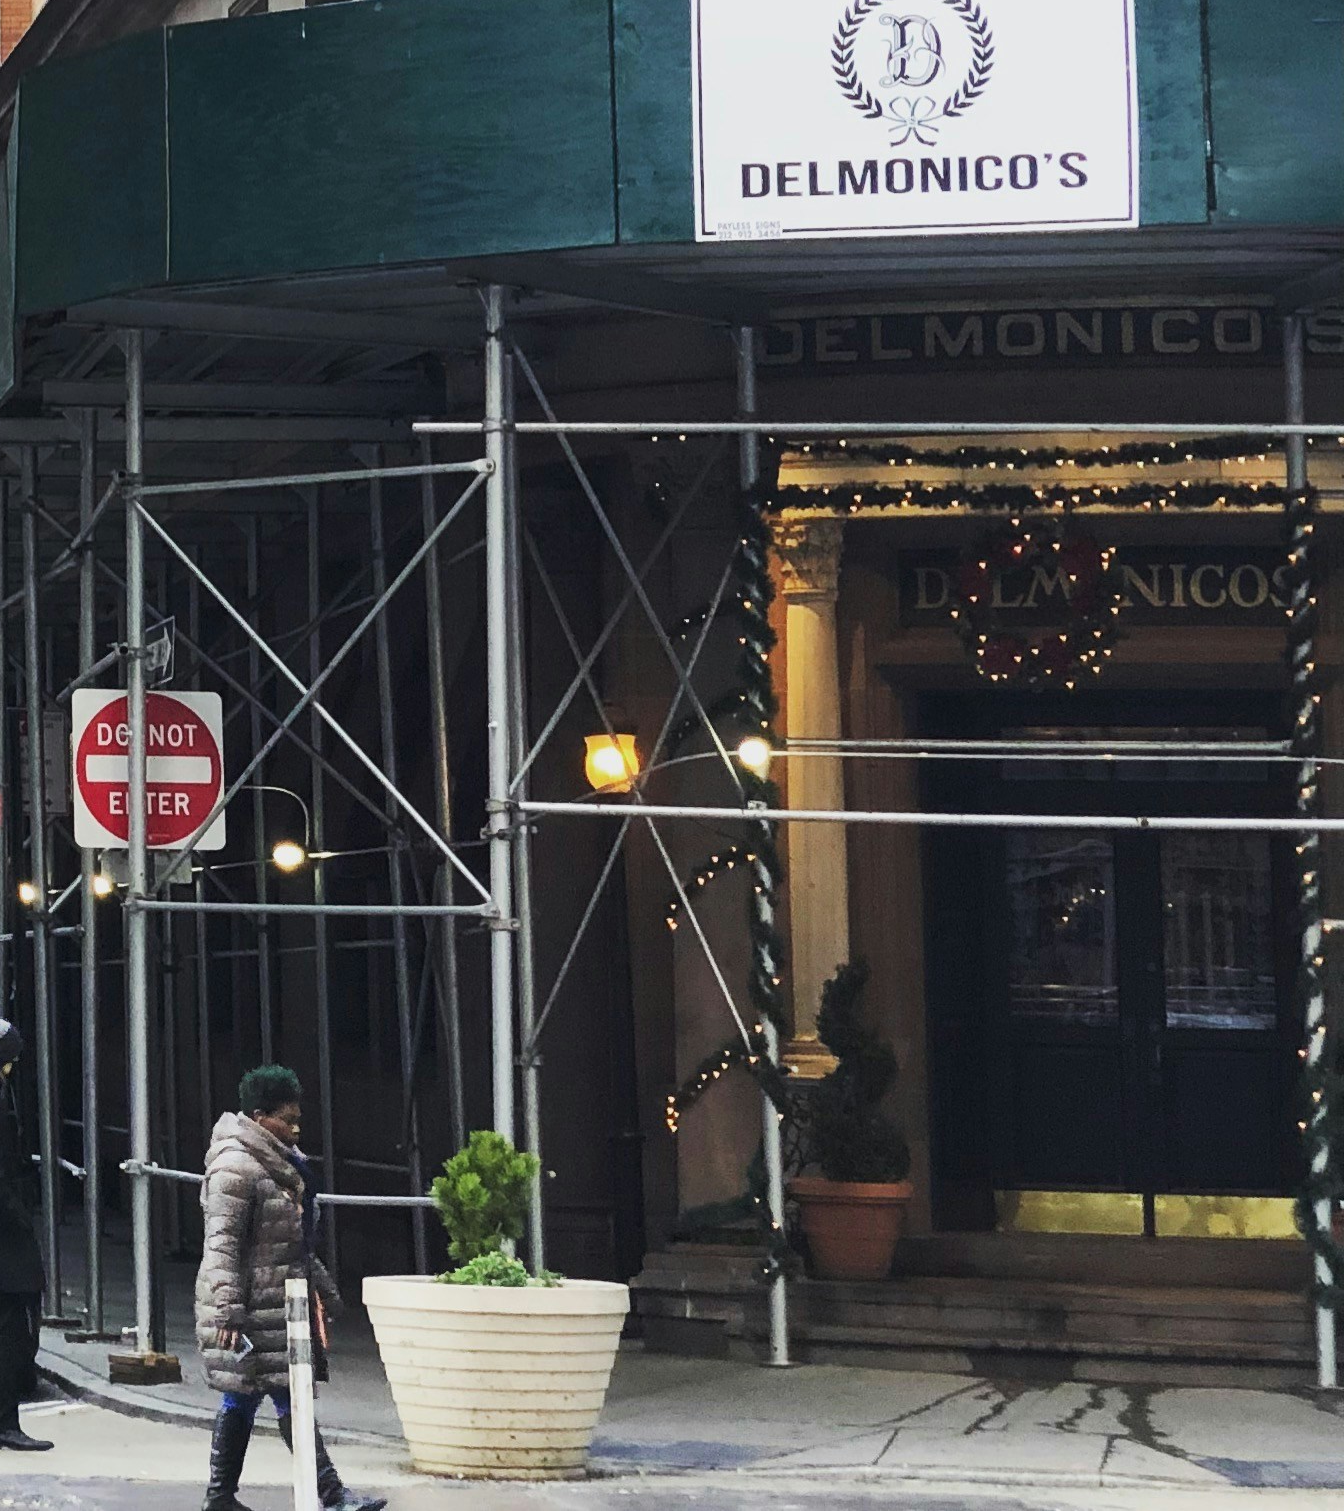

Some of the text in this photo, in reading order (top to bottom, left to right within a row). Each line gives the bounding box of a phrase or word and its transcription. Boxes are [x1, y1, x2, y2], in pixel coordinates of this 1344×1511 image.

[741, 151, 1088, 199] DELMONICO'S
[755, 220, 781, 229] SIGNS
[149, 723, 198, 747] NOT
[109, 791, 190, 816] ETER
